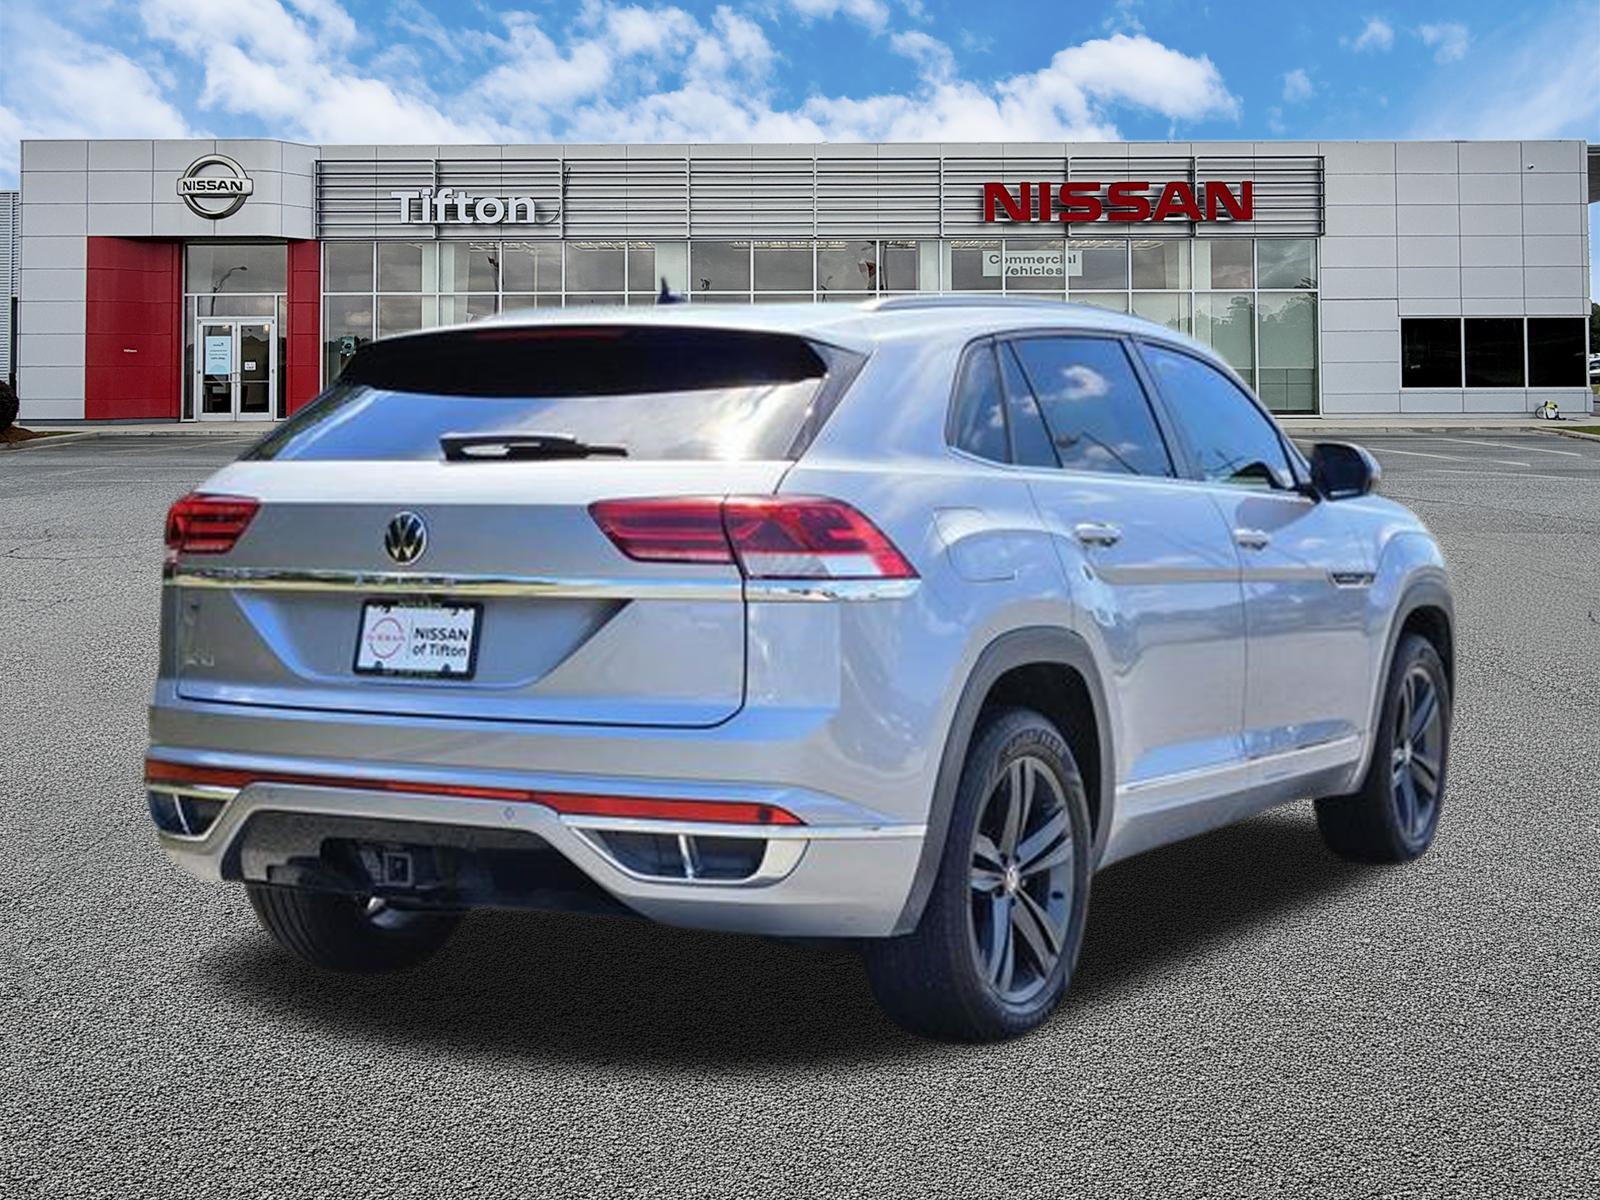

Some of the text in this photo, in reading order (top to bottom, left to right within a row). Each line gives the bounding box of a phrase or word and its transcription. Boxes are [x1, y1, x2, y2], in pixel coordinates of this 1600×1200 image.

[182, 180, 243, 191] NISSAN
[391, 188, 536, 224] Tifton
[983, 181, 1253, 222] NISSAN
[414, 627, 469, 641] NISSAN
[412, 643, 467, 656] of Tifton
